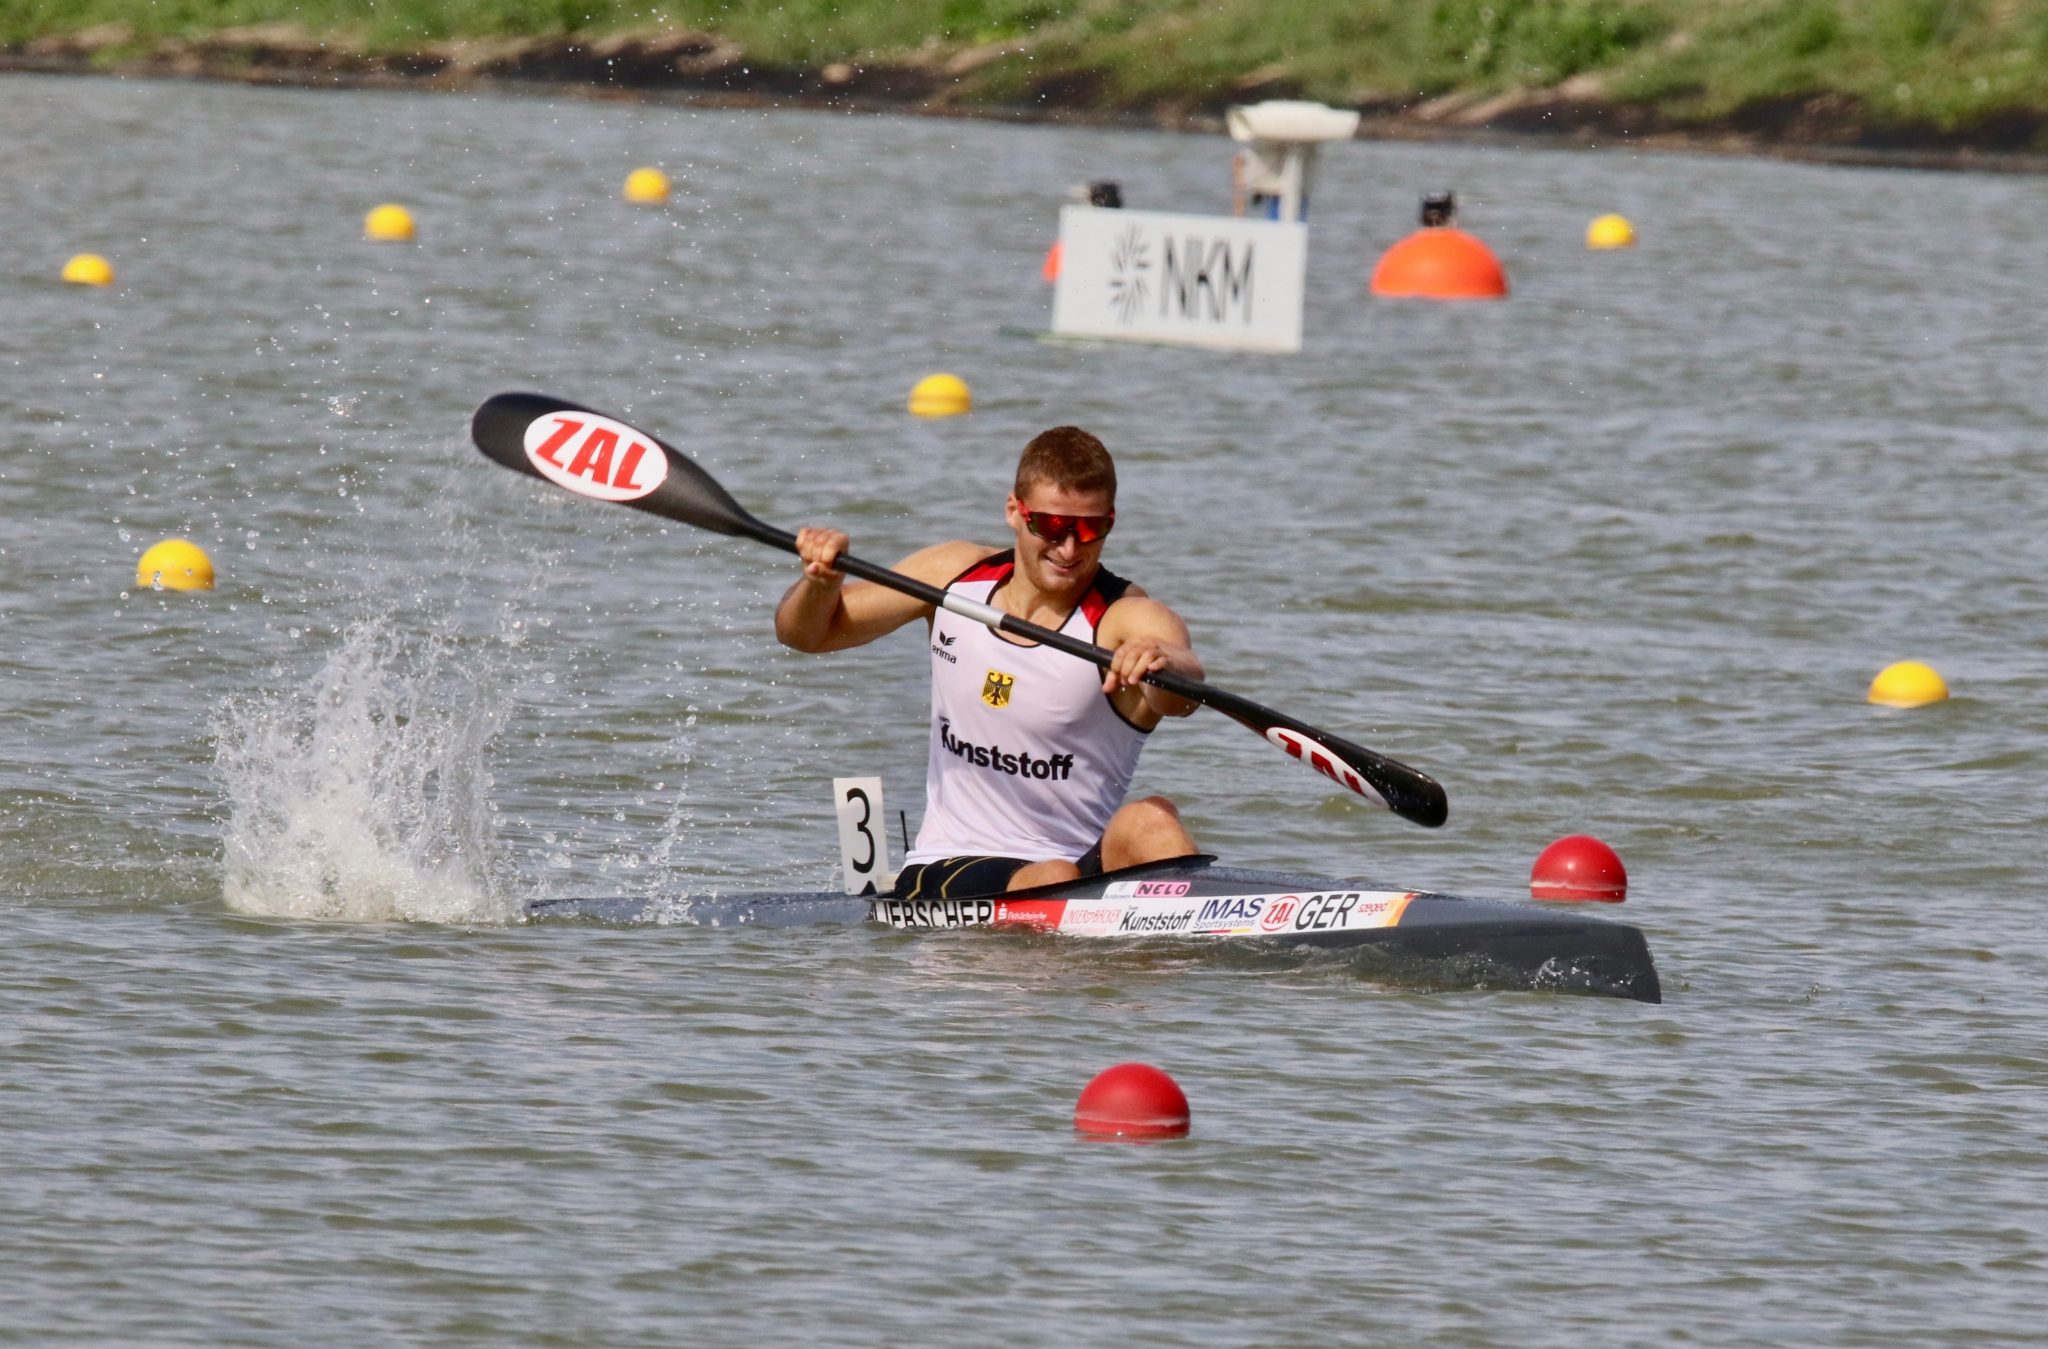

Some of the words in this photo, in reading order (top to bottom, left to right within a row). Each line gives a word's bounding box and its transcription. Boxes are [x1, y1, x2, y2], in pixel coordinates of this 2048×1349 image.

[1160, 236, 1255, 324] NKM
[535, 418, 647, 490] ZAL
[932, 644, 957, 664] erima
[941, 723, 1073, 780] Kunststoff
[846, 787, 875, 874] 3
[1138, 883, 1188, 895] NELO
[1119, 909, 1195, 931] Kunststoff
[1198, 898, 1265, 920] IMAS
[1264, 902, 1295, 924] ZAL
[1295, 893, 1360, 930] GER
[1193, 919, 1256, 930] Sportsystems
